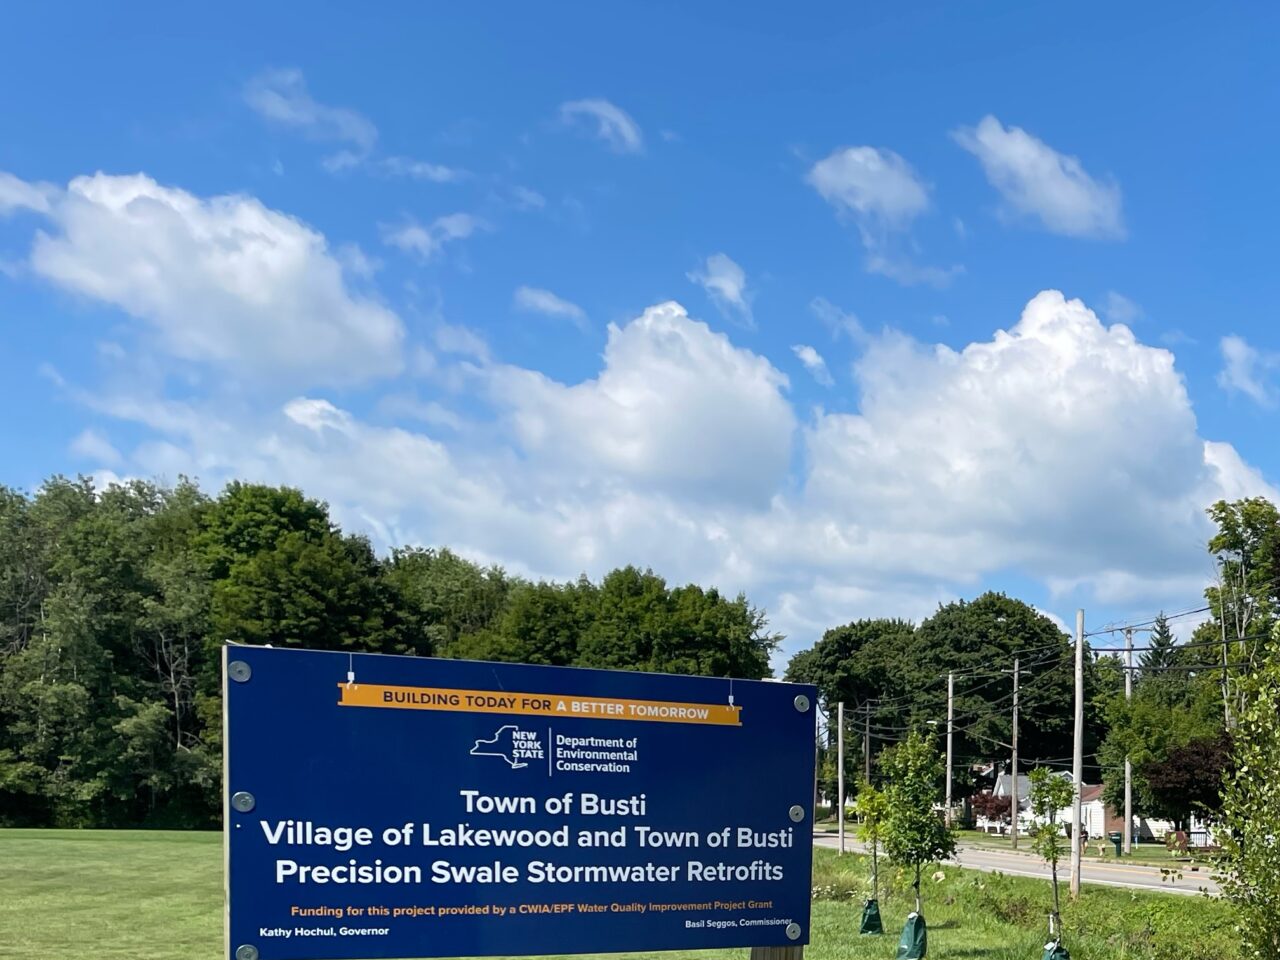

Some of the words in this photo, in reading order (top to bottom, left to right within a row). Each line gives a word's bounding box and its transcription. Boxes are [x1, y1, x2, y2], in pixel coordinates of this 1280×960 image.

[383, 691, 460, 706] BUILDING
[465, 695, 516, 709] TODAY
[522, 699, 551, 710] FOR
[556, 701, 567, 712] A
[571, 701, 624, 714] BETTER
[629, 705, 709, 720] TOMORROW
[512, 731, 537, 740] NEW
[556, 735, 624, 749] Department
[626, 738, 637, 748] of
[512, 740, 541, 750] YORK
[512, 750, 544, 759] STATE
[556, 748, 638, 761] Environmental
[556, 760, 630, 773] Conservation
[460, 790, 536, 814] Town
[545, 793, 573, 815] of
[580, 793, 646, 816] Busti
[260, 820, 373, 851] Village
[382, 822, 414, 846] of
[422, 823, 569, 847] Lakewood
[577, 826, 626, 847] and
[634, 826, 699, 848] Town
[707, 827, 731, 848] of
[737, 827, 793, 848] Busti
[276, 859, 421, 883] Precision
[431, 861, 519, 884] Swale
[527, 860, 680, 883] Stormwater
[687, 859, 783, 881] Retrofits
[291, 906, 343, 918] Funding
[347, 906, 364, 916] for
[367, 906, 390, 916] this
[393, 905, 435, 917] project
[438, 905, 489, 917] provided
[492, 904, 506, 915] by
[509, 906, 516, 914] a
[519, 903, 574, 914] CWIA/EPF
[577, 903, 608, 913] Water
[610, 903, 647, 914] Quality
[649, 902, 712, 913] Improvement
[714, 901, 745, 912] Project
[748, 900, 773, 909] Grant
[685, 920, 705, 928] Basil
[706, 919, 738, 929] Seggos,
[259, 927, 292, 938] Kathy
[294, 927, 337, 937] Hochul,
[339, 926, 390, 936] Governor
